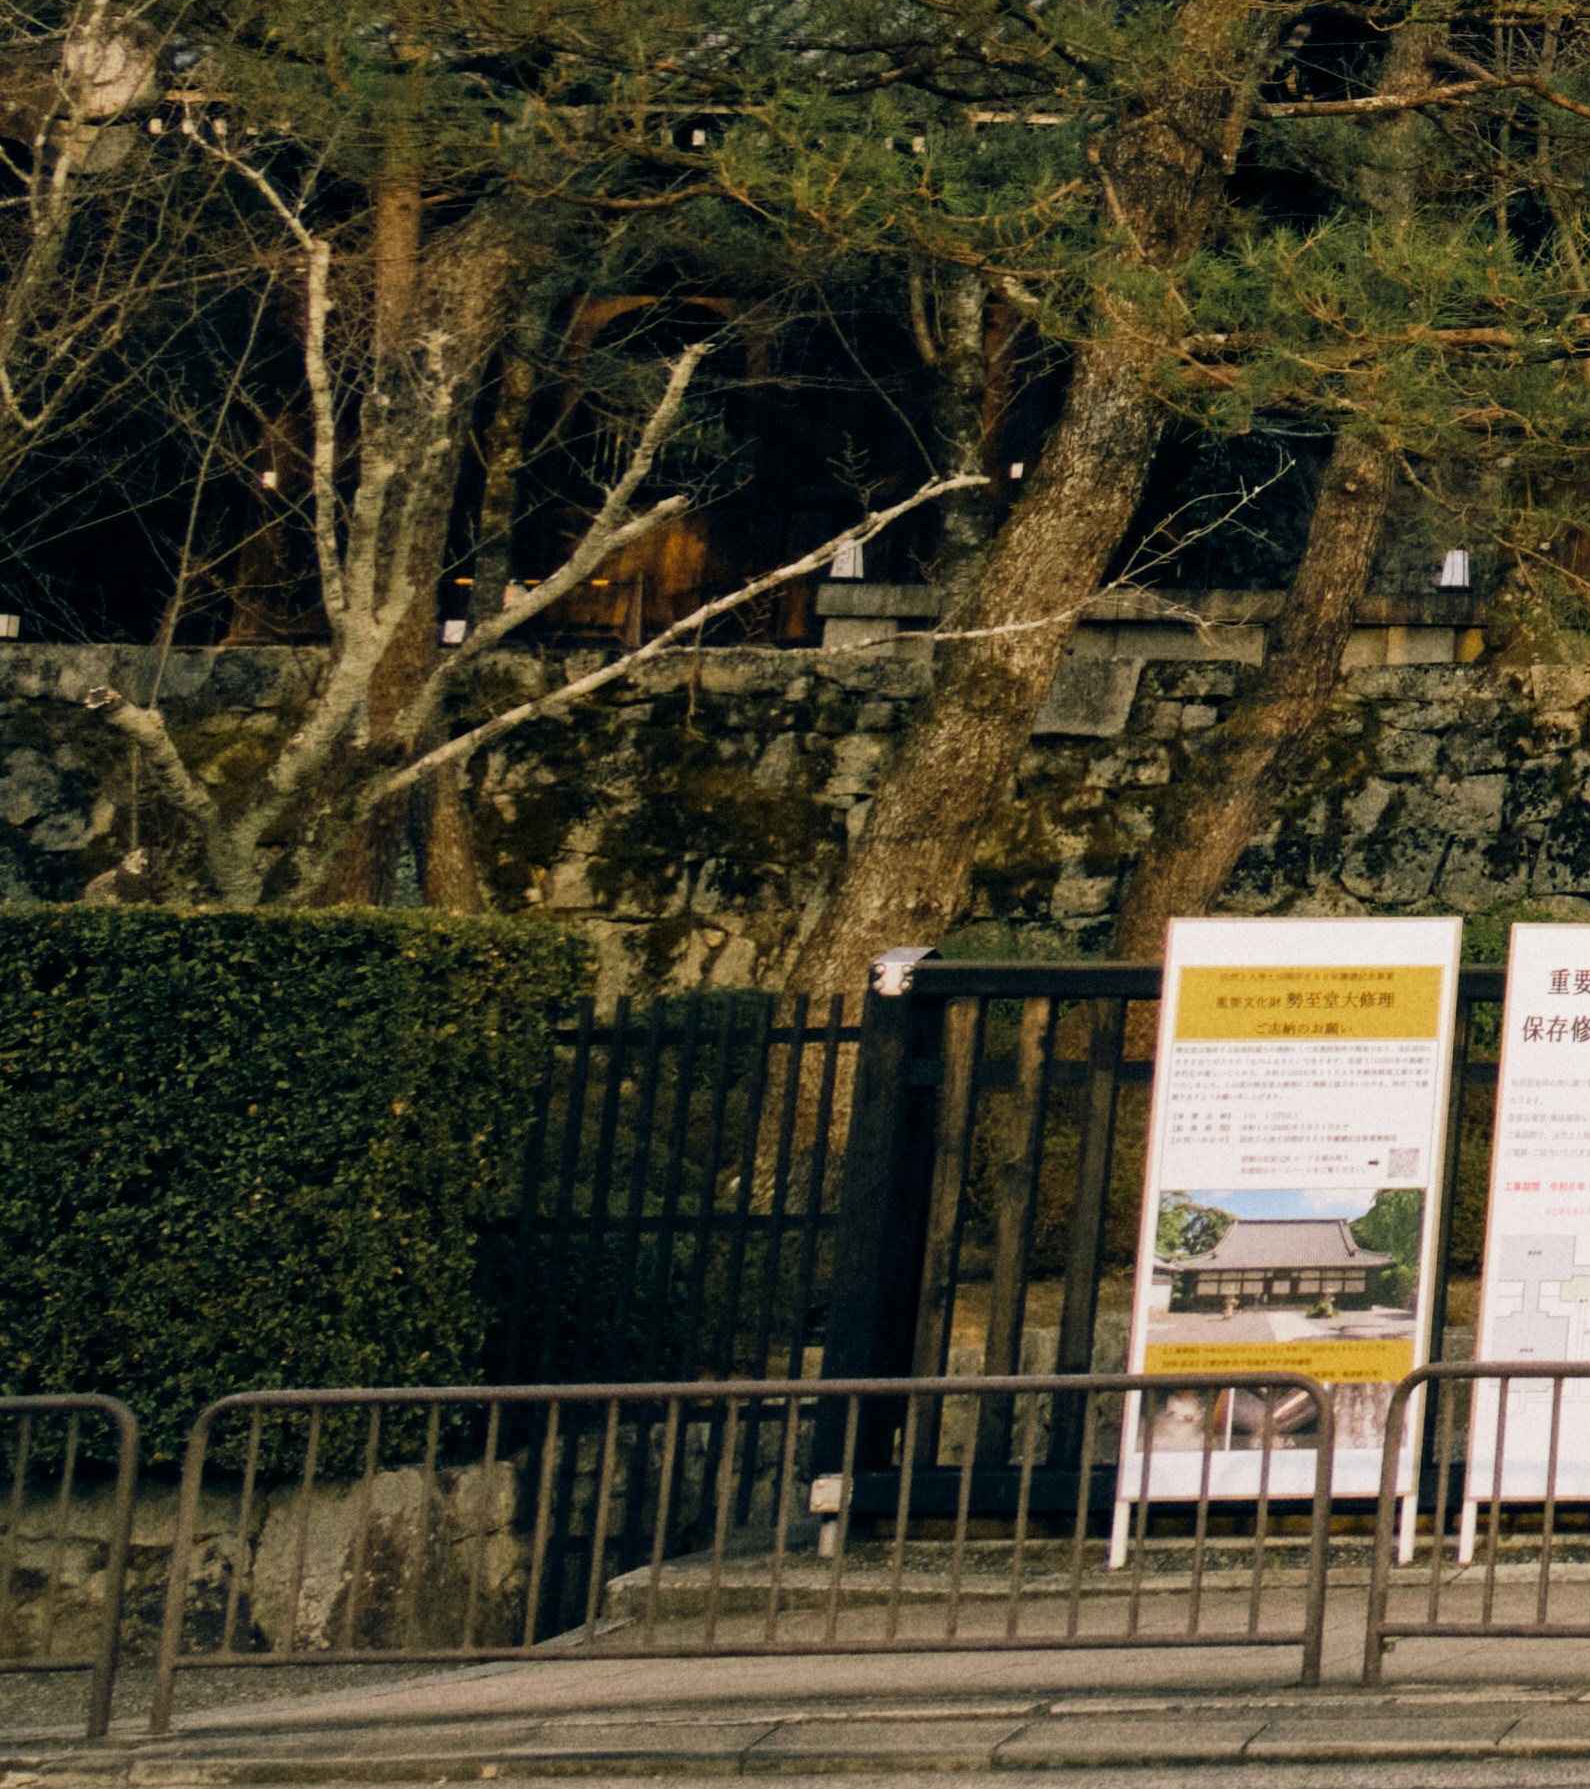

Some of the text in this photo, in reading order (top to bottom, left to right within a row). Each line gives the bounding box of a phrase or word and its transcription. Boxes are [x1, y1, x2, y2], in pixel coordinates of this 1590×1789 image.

[1216, 991, 1396, 1010] 重要文化財 勢至堂大修理
[1504, 1181, 1541, 1193] 工事期間
